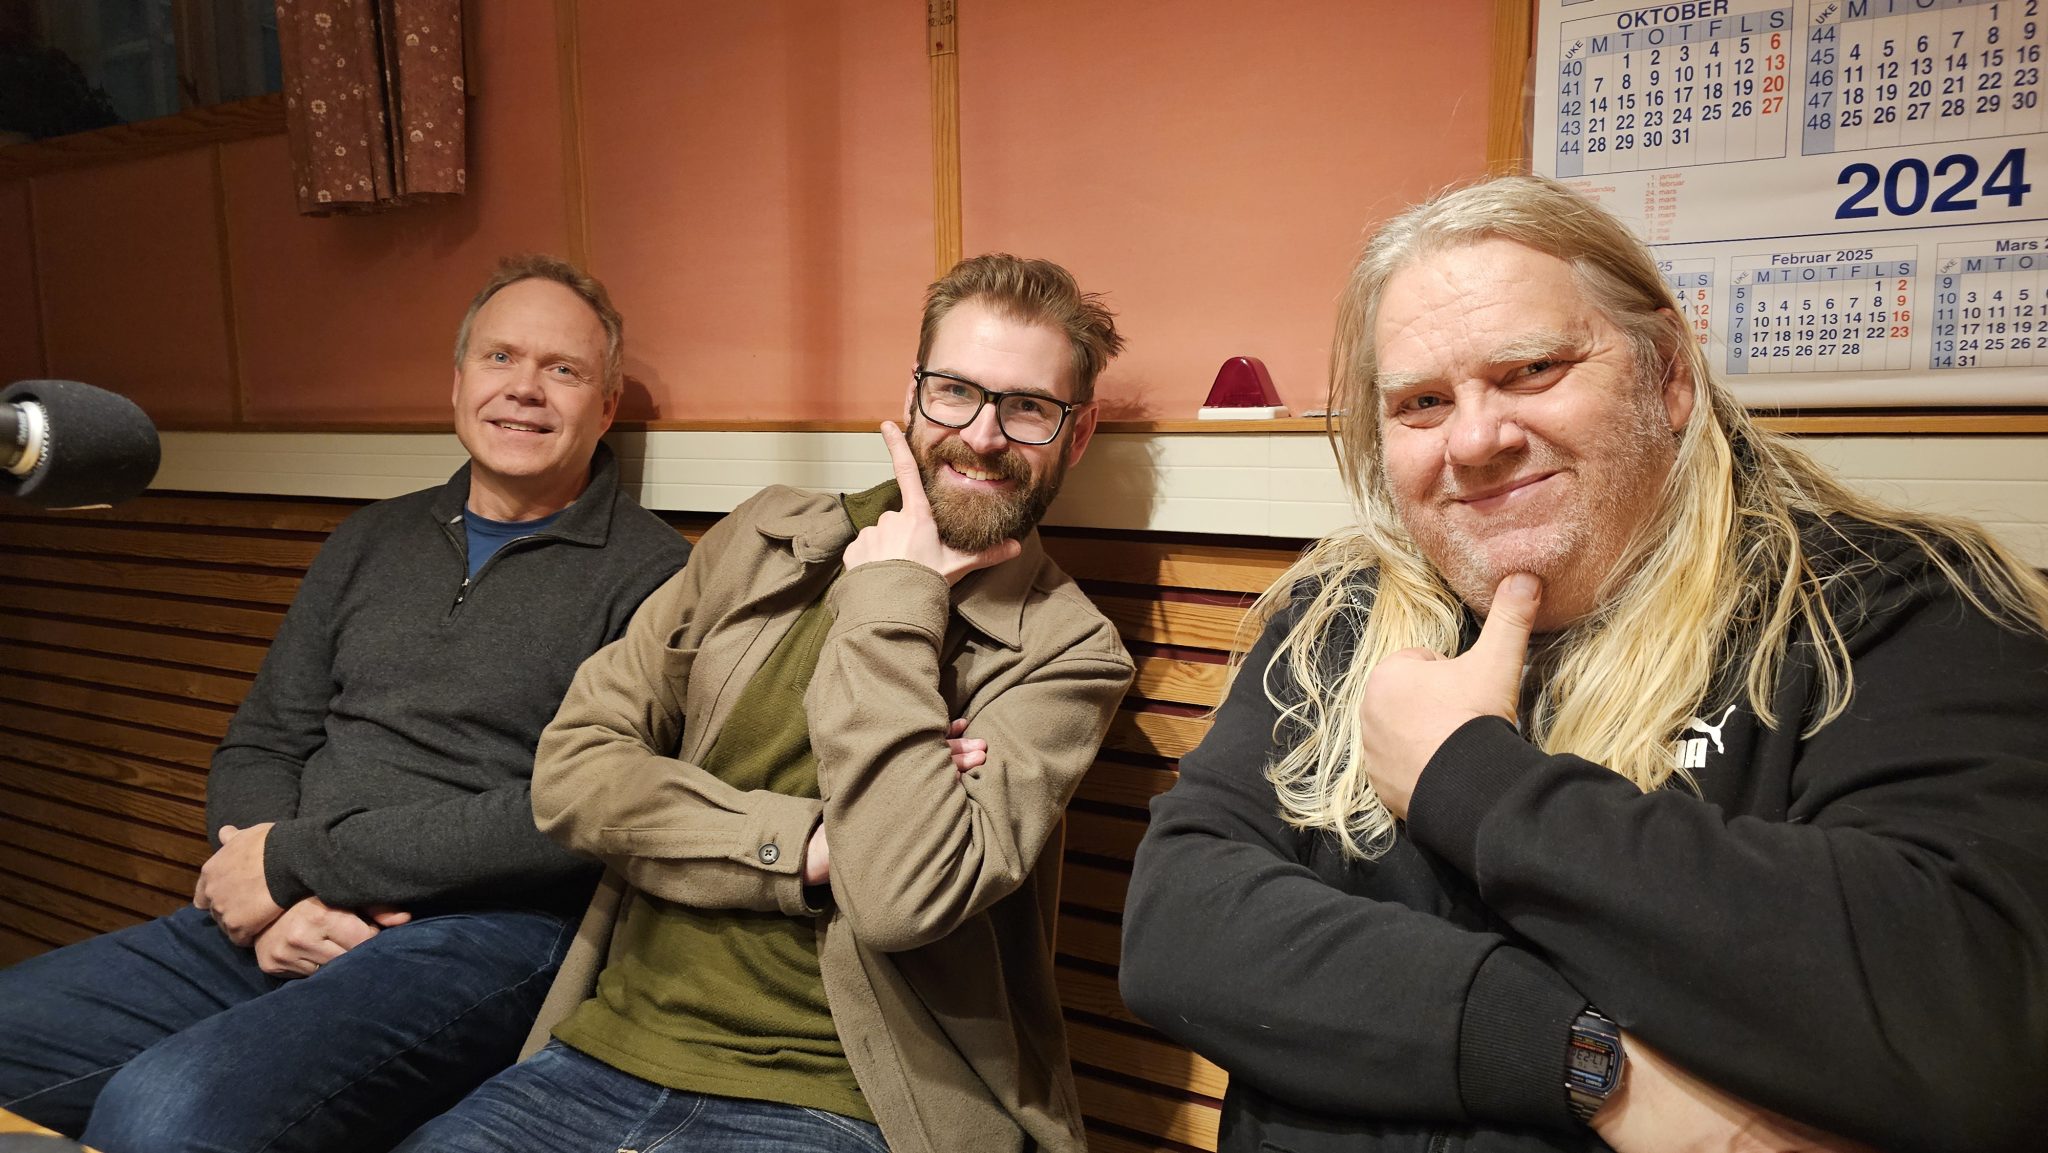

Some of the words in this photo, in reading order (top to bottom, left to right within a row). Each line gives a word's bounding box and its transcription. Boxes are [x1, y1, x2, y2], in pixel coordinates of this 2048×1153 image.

[1617, 0, 1729, 29] OKTOBER
[1811, 26, 1836, 44] 44
[1990, 3, 1999, 21] 1
[2025, 0, 2038, 17] 2
[1816, 4, 1838, 24] UKE
[1848, 0, 1867, 18] M
[1565, 40, 1583, 60] UKE
[1592, 36, 1608, 54] M
[1621, 32, 1635, 49] T
[1648, 28, 1664, 45] O
[1678, 24, 1693, 40] T
[1709, 19, 1722, 37] F
[1741, 16, 1753, 33] L
[1769, 11, 1784, 29] S
[1810, 48, 1835, 65] 45
[1850, 44, 1861, 60] 4
[1883, 40, 1894, 57] 5
[1917, 35, 1928, 53] 6
[1952, 31, 1964, 49] 7
[1987, 26, 1999, 45] 8
[2024, 22, 2036, 40] 9
[1562, 61, 1582, 77] 40
[1623, 53, 1629, 69] 1
[1651, 49, 1660, 65] 2
[1680, 45, 1689, 62] 3
[1709, 41, 1719, 57] 4
[1740, 37, 1750, 54] 5
[1770, 33, 1781, 50] 6
[1562, 81, 1579, 96] 41
[1594, 77, 1604, 93] 7
[1622, 74, 1631, 90] 8
[1650, 70, 1659, 86] 9
[1675, 66, 1694, 83] 10
[1704, 62, 1721, 79] 11
[1735, 58, 1754, 75] 12
[1765, 54, 1785, 71] 13
[1809, 69, 1833, 87] 46
[1844, 65, 1863, 83] 11
[1877, 61, 1898, 79] 12
[1911, 57, 1932, 76] 13
[1945, 53, 1968, 72] 14
[1980, 49, 2004, 68] 15
[2017, 44, 2040, 63] 16
[1561, 100, 1581, 116] 42
[1590, 97, 1608, 113] 14
[1617, 93, 1635, 110] 15
[1646, 90, 1664, 106] 16
[1674, 86, 1693, 103] 17
[1704, 83, 1723, 100] 18
[1734, 79, 1753, 96] 19
[1763, 75, 1784, 93] 20
[1808, 91, 1833, 109] 47
[1843, 87, 1864, 105] 18
[1876, 84, 1897, 101] 19
[1908, 80, 1932, 98] 20
[1943, 76, 1964, 95] 21
[1978, 72, 2002, 91] 22
[2014, 68, 2039, 87] 23
[1561, 120, 1581, 136] 43
[1589, 117, 1605, 133] 21
[1616, 114, 1635, 130] 22
[1644, 110, 1663, 127] 23
[1673, 107, 1692, 124] 24
[1702, 104, 1722, 121] 25
[1731, 100, 1752, 118] 26
[1762, 96, 1783, 114] 27
[1807, 113, 1831, 130] 48
[1840, 109, 1862, 127] 25
[1873, 106, 1896, 124] 26
[1907, 102, 1931, 121] 27
[1941, 98, 1965, 117] 28
[1976, 94, 2000, 113] 29
[2012, 90, 2037, 110] 30
[1560, 140, 1580, 155] 44
[1588, 137, 1606, 153] 28
[1615, 134, 1634, 150] 29
[1643, 131, 1662, 147] 30
[1672, 128, 1689, 145] 31
[1835, 148, 2032, 220] 2024
[1996, 239, 2038, 252] Mars
[1772, 253, 1831, 265] Februar
[1836, 249, 1873, 262] 2025
[1967, 259, 1982, 271] M
[1994, 257, 2006, 270] T
[2019, 256, 2033, 269] O
[1678, 276, 1686, 287] L
[1698, 274, 1708, 286] S
[1757, 271, 1770, 283] M
[1781, 270, 1791, 281] T
[1803, 268, 1815, 280] O
[1827, 267, 1838, 279] T
[1851, 266, 1861, 278] F
[1875, 265, 1885, 276] L
[1898, 263, 1910, 275] S
[1943, 277, 1953, 289] 9
[1677, 290, 1685, 301] 4
[1698, 289, 1706, 300] 5
[1736, 287, 1745, 299] 5
[1875, 280, 1881, 292] 1
[1898, 279, 1907, 291] 2
[1938, 292, 1957, 304] 10
[1967, 291, 1977, 303] 3
[1993, 290, 2003, 301] 4
[2019, 289, 2029, 301] 5
[1736, 302, 1744, 314] 6
[1758, 301, 1766, 312] 3
[1780, 300, 1788, 311] 4
[1802, 299, 1811, 310] 5
[1826, 298, 1834, 309] 6
[1850, 297, 1859, 308] 7
[1873, 296, 1882, 307] 8
[1897, 295, 1906, 306] 9
[1938, 309, 1953, 320] 11
[1962, 307, 1981, 319] 10
[1988, 306, 2005, 318] 11
[2014, 305, 2033, 317] 12
[1735, 317, 1744, 328] 7
[1753, 316, 1770, 327] 10
[1776, 315, 1790, 327] 11
[1798, 314, 1815, 326] 12
[1821, 313, 1838, 325] 13
[1845, 312, 1862, 324] 14
[1868, 311, 1886, 323] 15
[1892, 310, 1910, 322] 16
[1936, 324, 1955, 336] 12
[1961, 323, 1980, 335] 17
[1987, 322, 2006, 334] 18
[2012, 321, 2032, 333] 19
[1734, 332, 1743, 344] 8
[1752, 331, 1769, 342] 17
[1775, 330, 1791, 341] 18
[1797, 329, 1814, 341] 19
[1819, 329, 1837, 340] 20
[1843, 328, 1859, 339] 21
[1866, 327, 1885, 338] 22
[1890, 326, 1909, 338] 23
[1935, 340, 1953, 352] 13
[1959, 339, 1979, 351] 24
[1984, 338, 2004, 350] 25
[2010, 337, 2031, 349] 26
[1734, 347, 1742, 359] 9
[1751, 346, 1768, 358] 24
[1773, 346, 1790, 357] 25
[1795, 345, 1813, 356] 26
[1818, 344, 1837, 355] 27
[1841, 343, 1860, 355] 28
[1934, 356, 1953, 368] 14
[1958, 355, 1975, 367] 31
